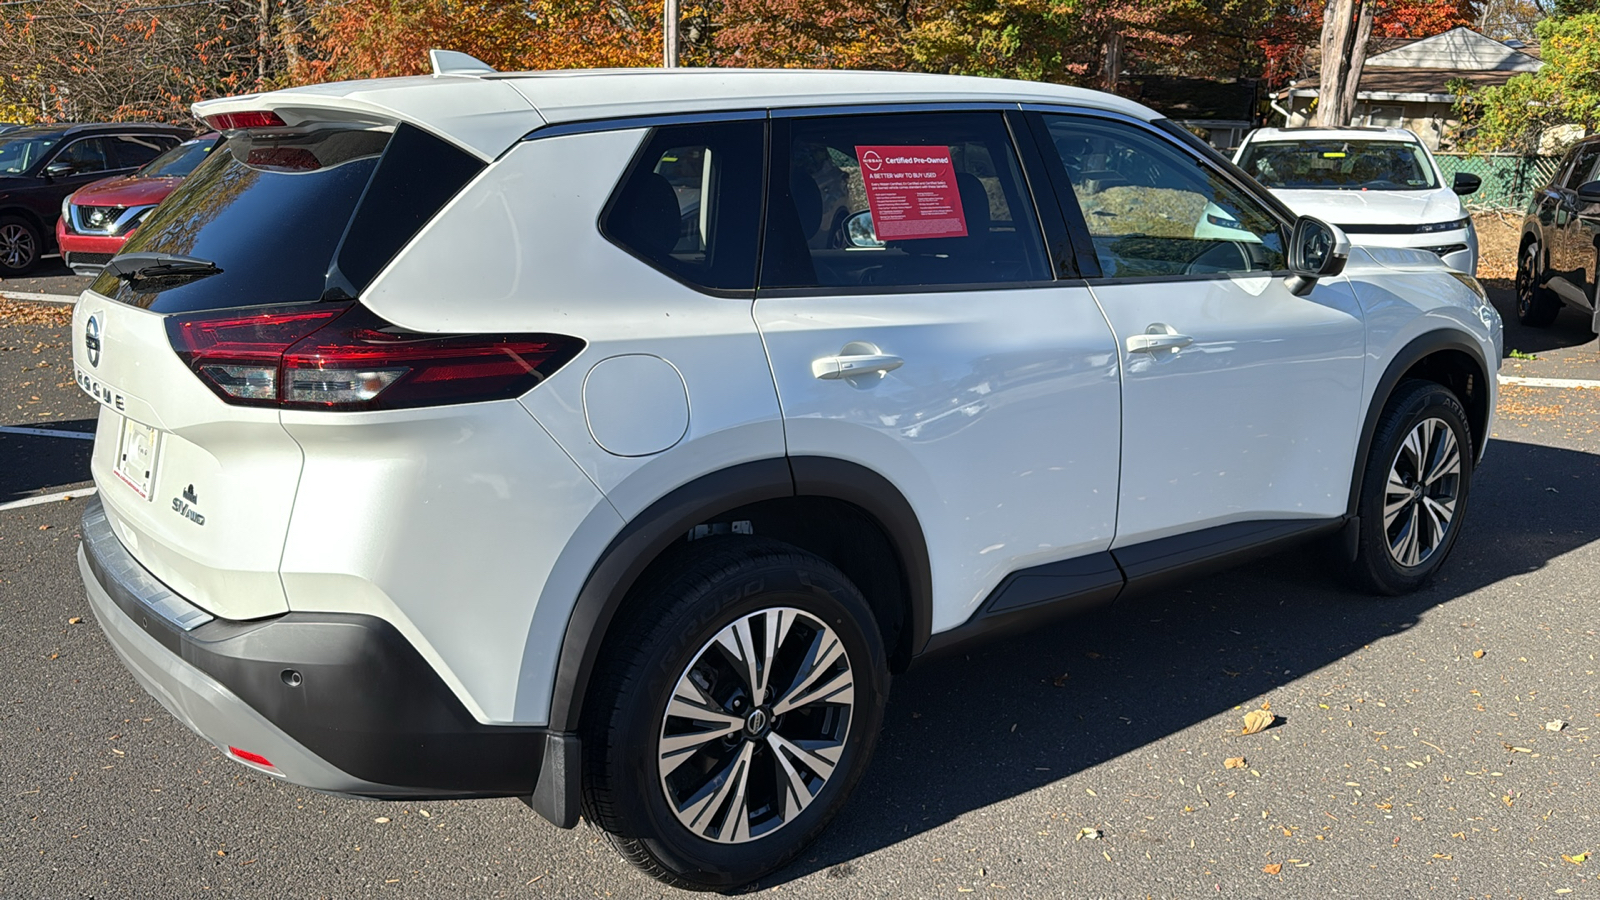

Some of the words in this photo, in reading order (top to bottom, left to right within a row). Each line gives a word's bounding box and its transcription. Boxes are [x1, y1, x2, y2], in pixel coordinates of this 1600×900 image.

[77, 369, 125, 411] ROGUE
[171, 497, 189, 516] SV
[185, 508, 206, 526] AWD
